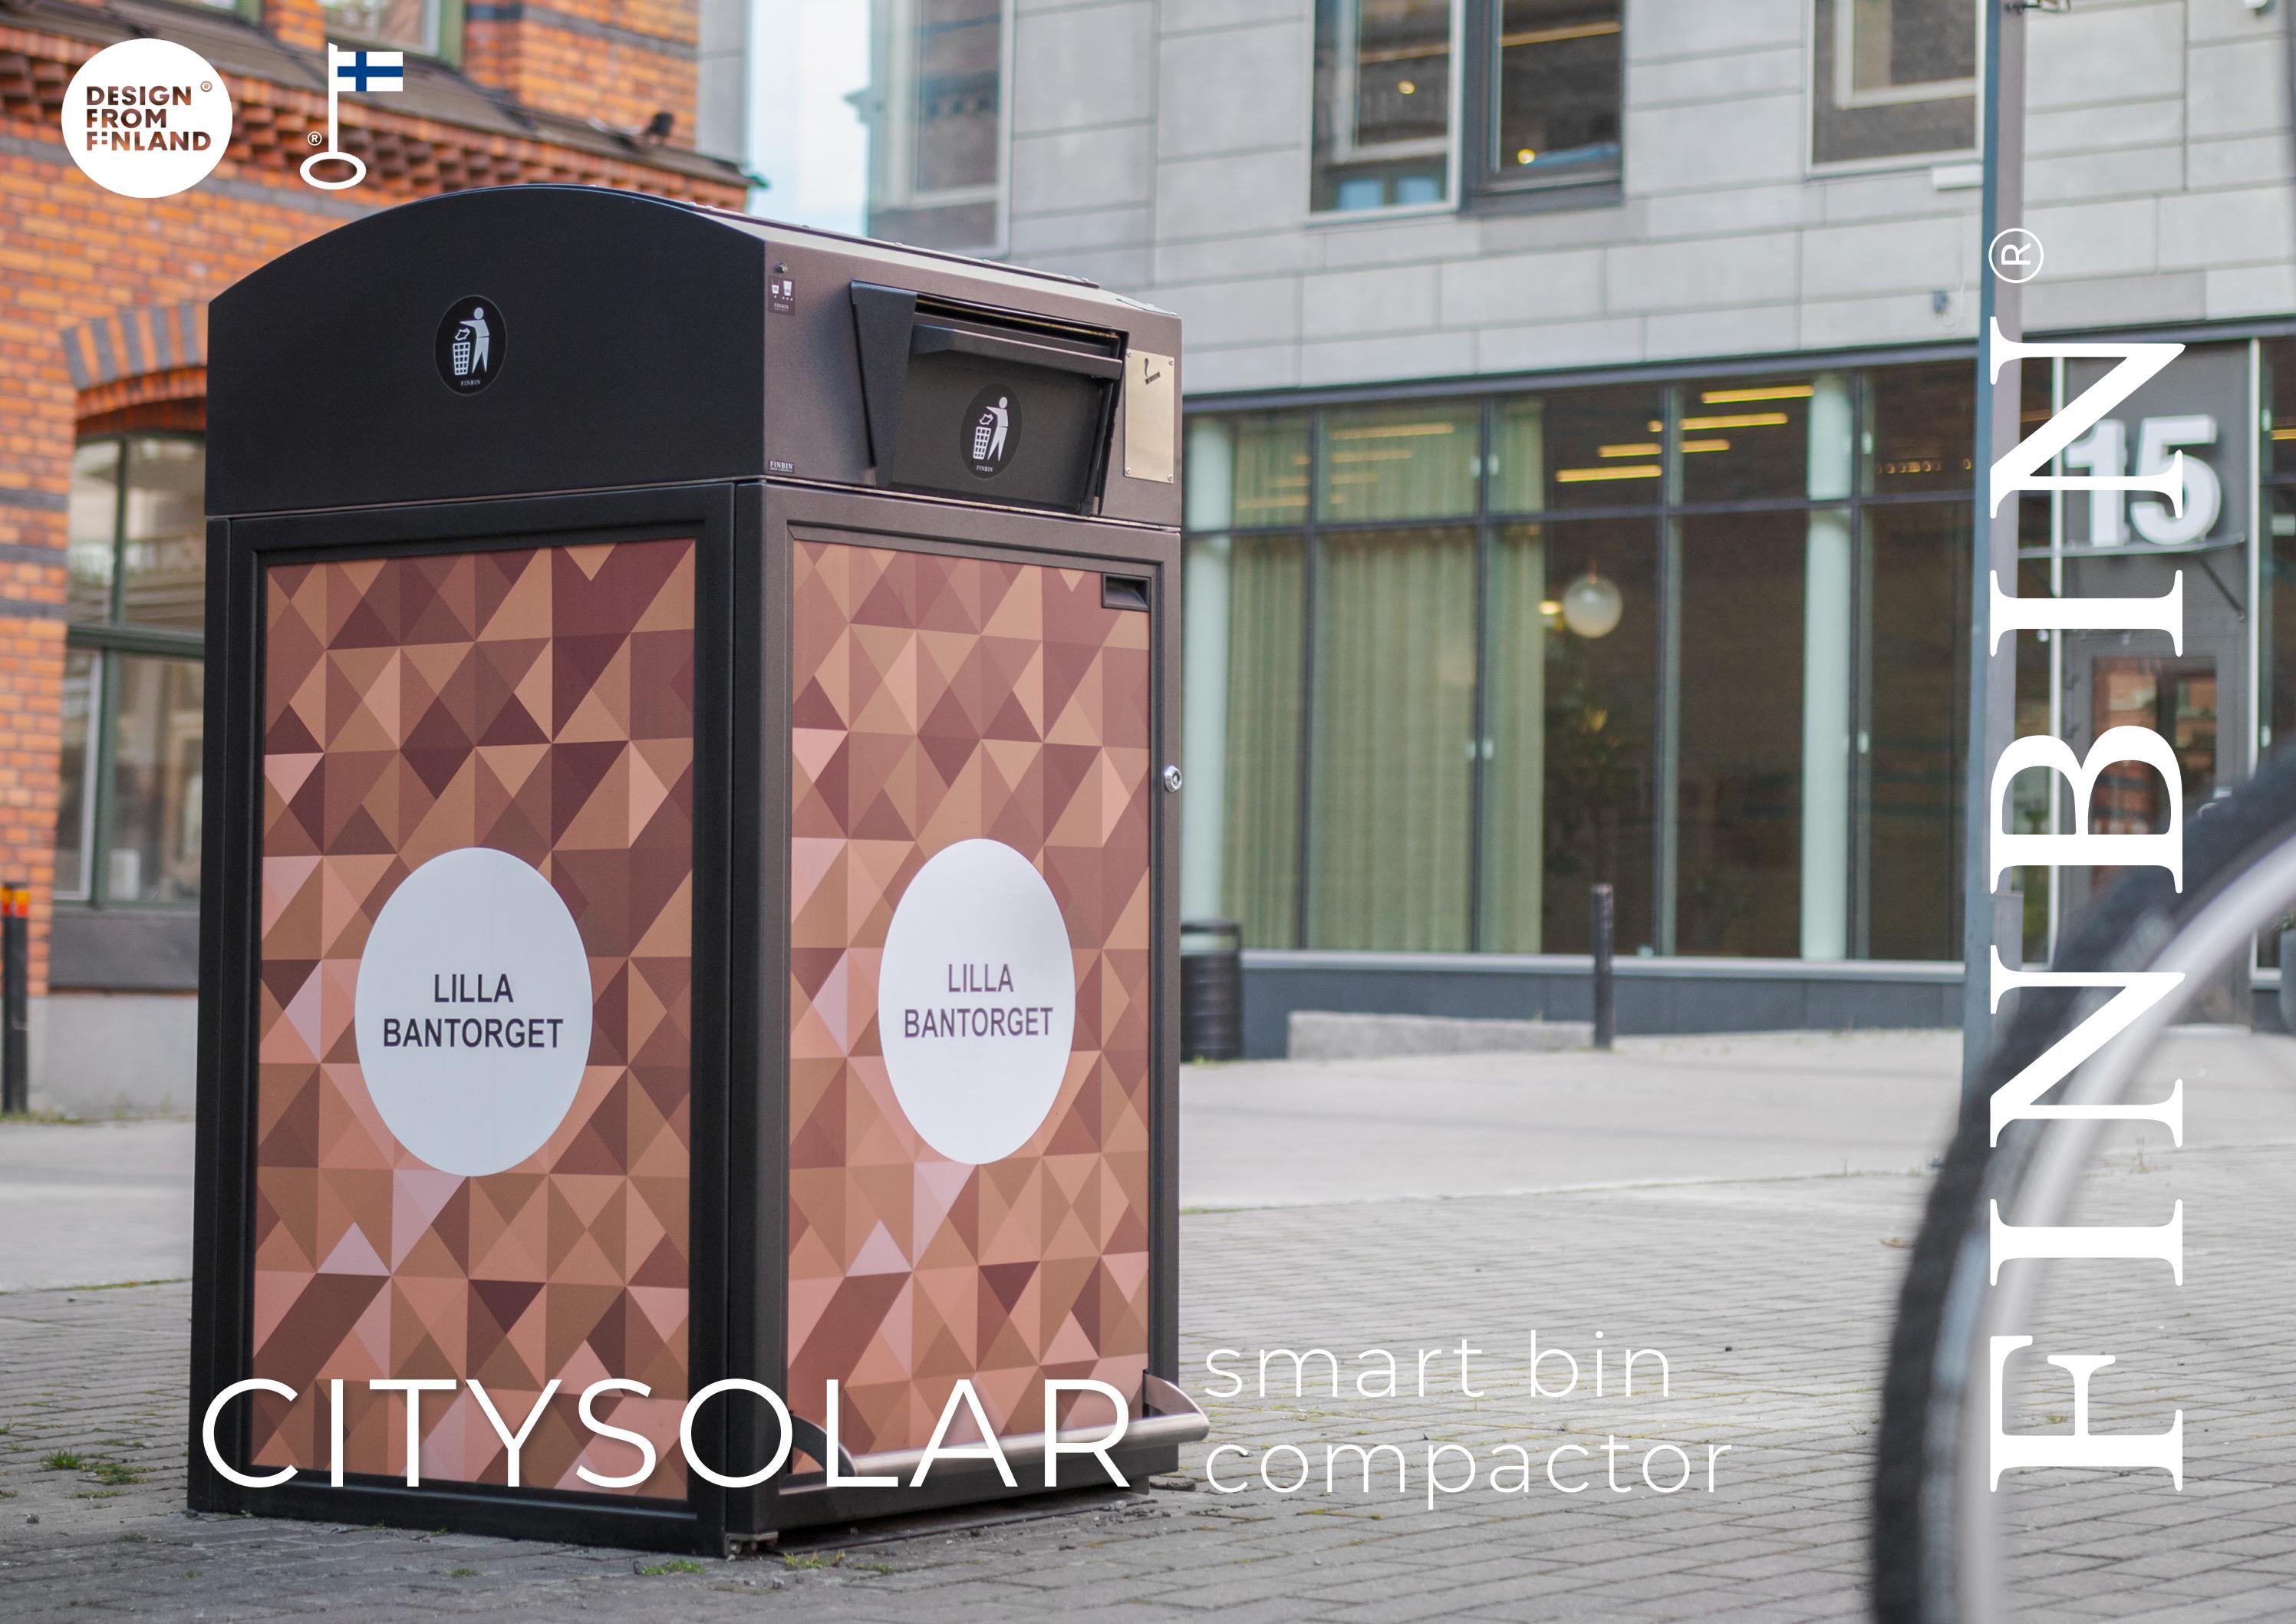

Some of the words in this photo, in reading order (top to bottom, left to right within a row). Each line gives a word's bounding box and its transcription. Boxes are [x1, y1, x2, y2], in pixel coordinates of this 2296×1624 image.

[769, 460, 793, 469] FINBIN
[2064, 414, 2223, 548] 15
[434, 973, 514, 1003] LILLA
[948, 964, 1014, 993] LILLA
[384, 1018, 564, 1048] BANTORGET
[904, 1006, 1053, 1038] BANTORGET
